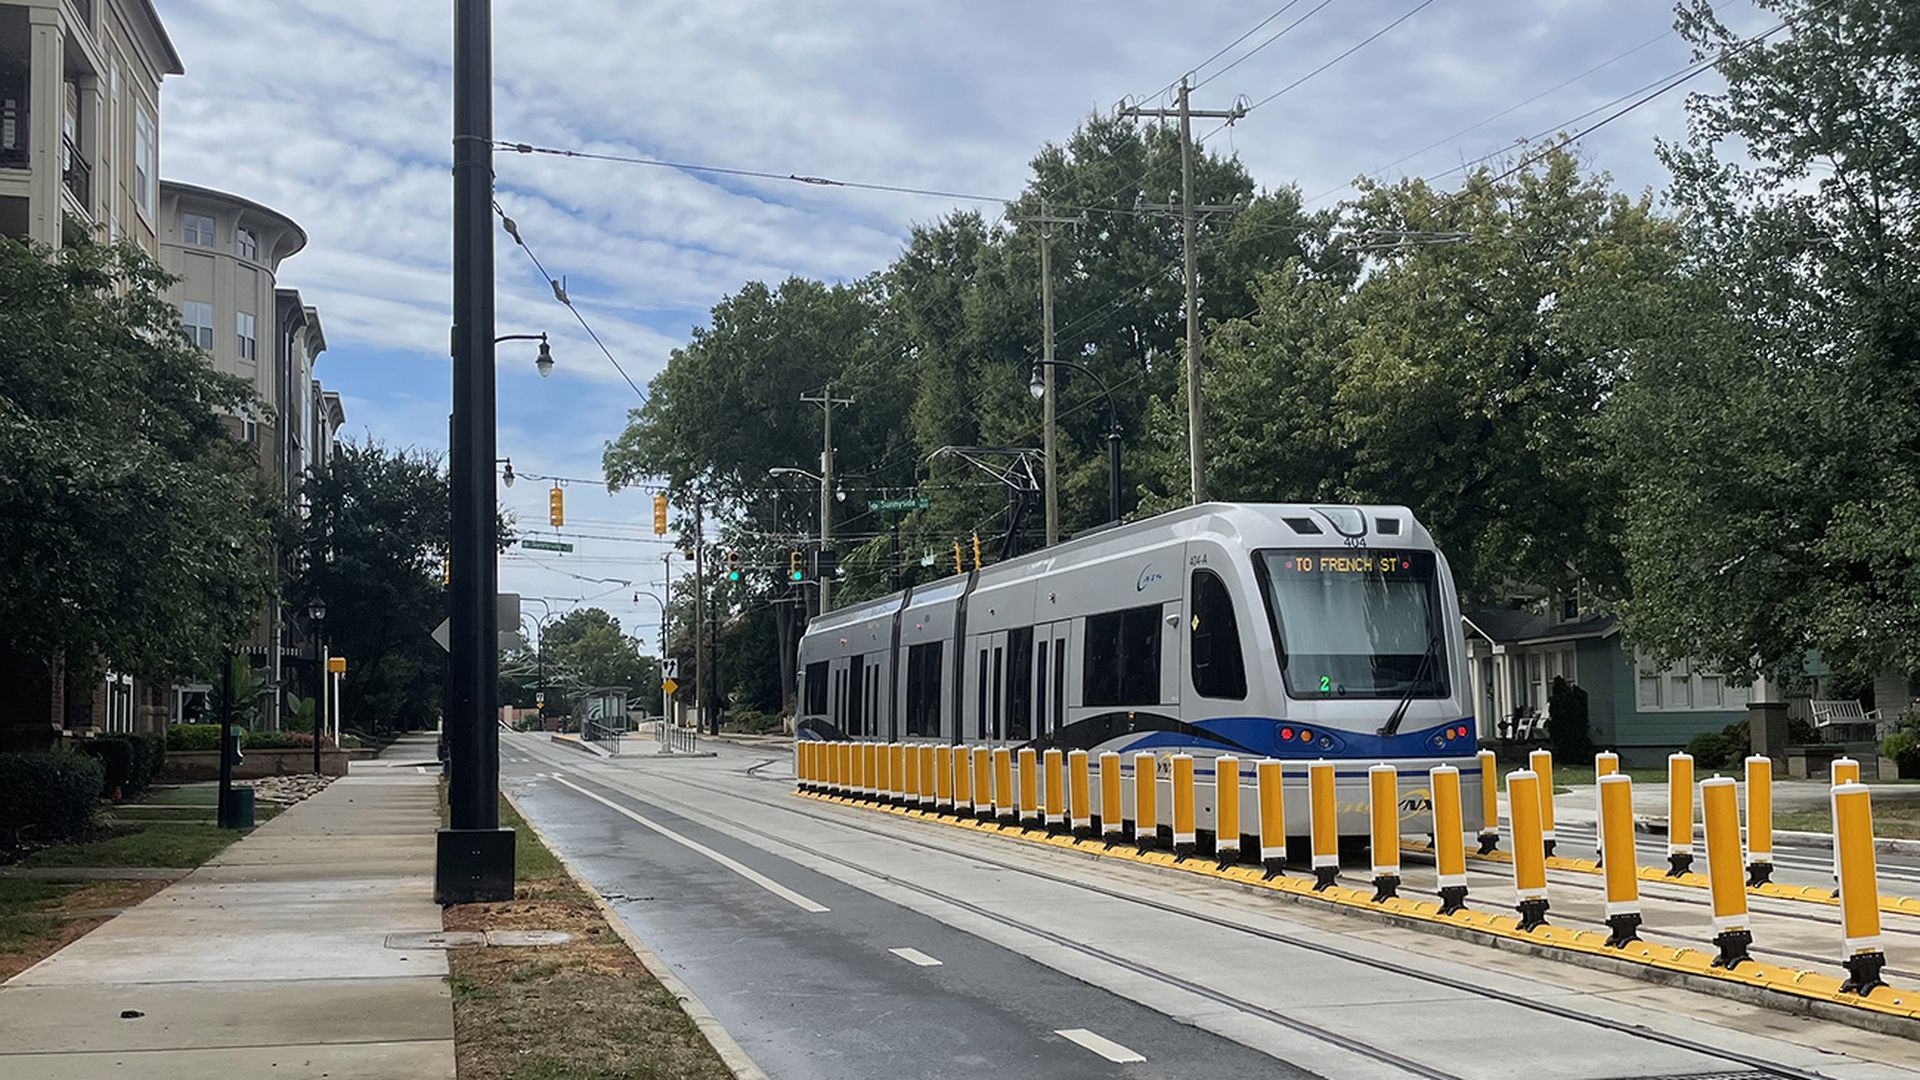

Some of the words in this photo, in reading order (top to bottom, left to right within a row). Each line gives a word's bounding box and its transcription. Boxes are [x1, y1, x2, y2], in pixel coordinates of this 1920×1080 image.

[1343, 537, 1367, 549] 404
[1296, 558, 1313, 572] TO
[1320, 558, 1373, 572] FRENCH
[1380, 558, 1397, 572] ST
[1320, 675, 1330, 692] 2
